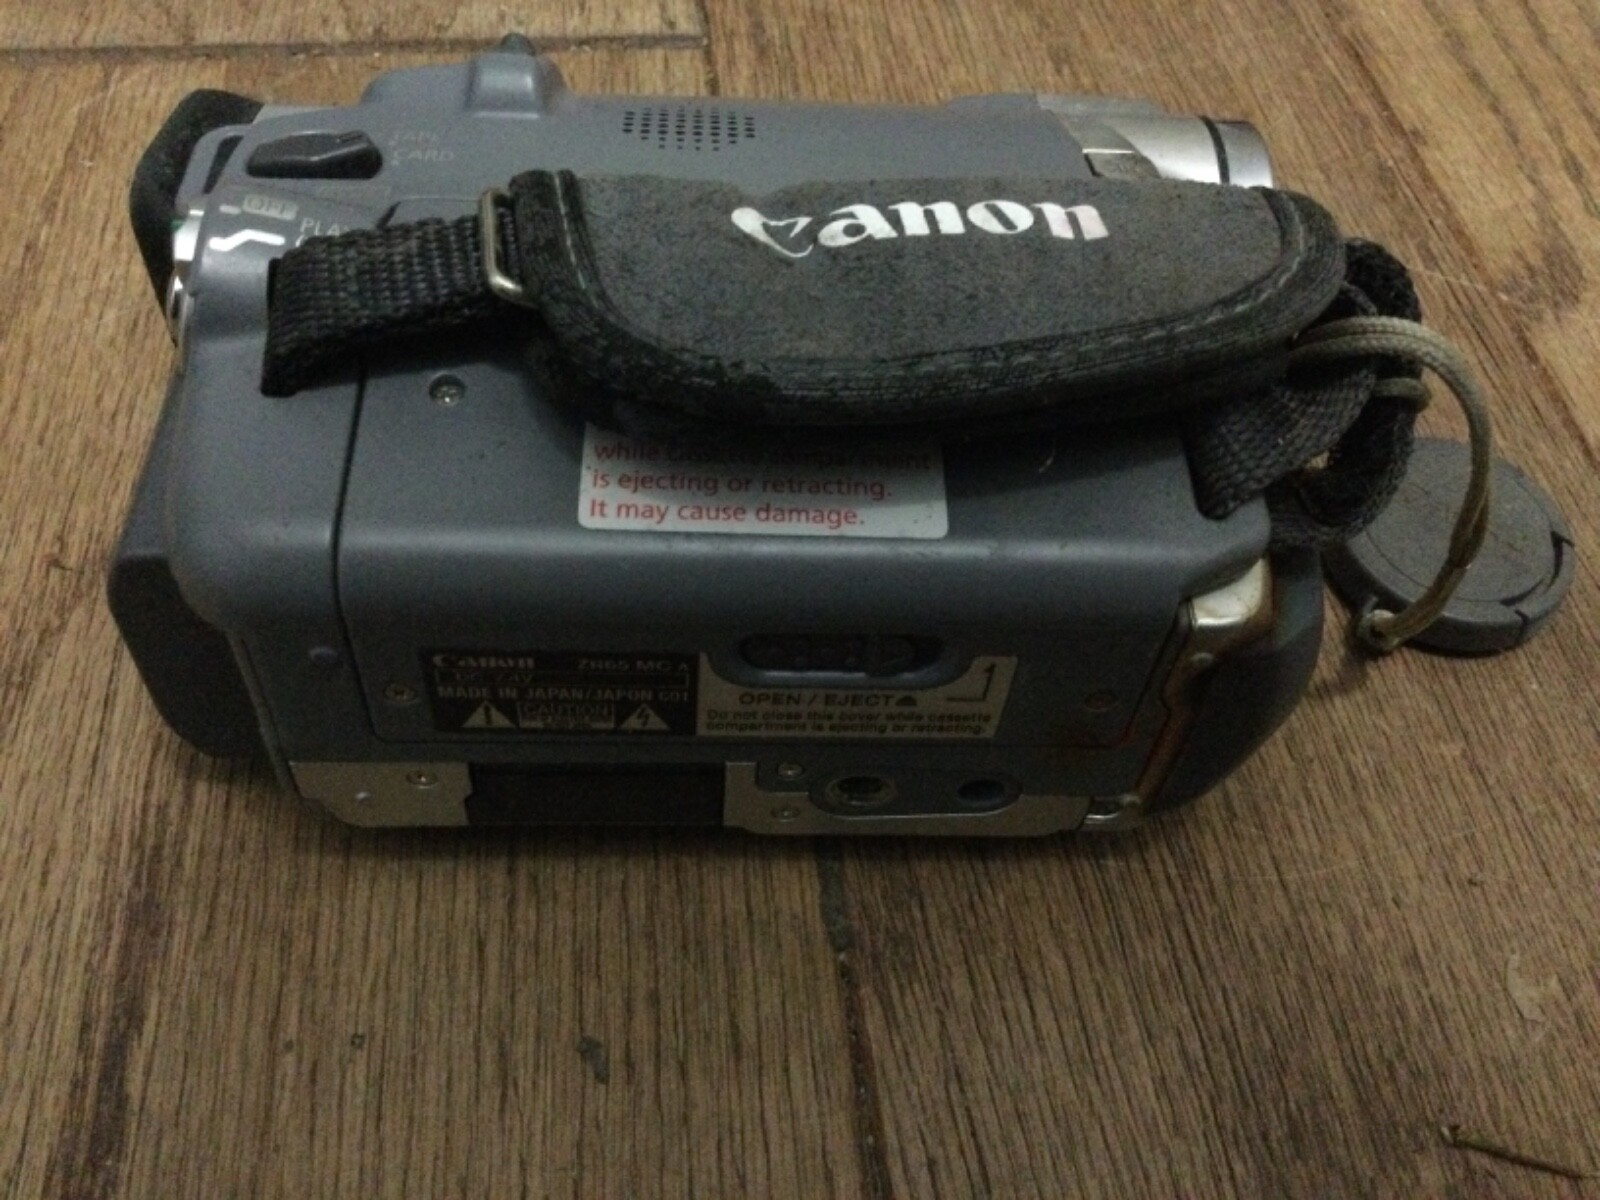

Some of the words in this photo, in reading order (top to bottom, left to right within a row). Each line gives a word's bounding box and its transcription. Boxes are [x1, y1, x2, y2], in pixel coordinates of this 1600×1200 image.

[731, 200, 1109, 257] Canon
[592, 470, 610, 488] is
[617, 472, 719, 497] ejecting
[727, 477, 752, 493] or
[762, 478, 892, 502] retracting.
[590, 499, 607, 518] It
[617, 504, 669, 525] may
[677, 505, 746, 522] cause
[755, 503, 864, 530] damage.
[432, 655, 535, 669] Canon
[436, 686, 490, 699] MADE
[498, 688, 517, 699] IN
[738, 693, 801, 706] OPEN
[824, 694, 894, 707] EJECT
[707, 709, 728, 721] Do
[733, 710, 757, 721] not
[762, 711, 802, 722] close
[807, 710, 833, 722] this
[839, 712, 881, 723] cover
[885, 712, 923, 723] while
[927, 713, 990, 724] cassette
[706, 722, 806, 734] compartment
[812, 722, 824, 732] is
[829, 722, 887, 735] ejecting
[891, 724, 907, 733] or
